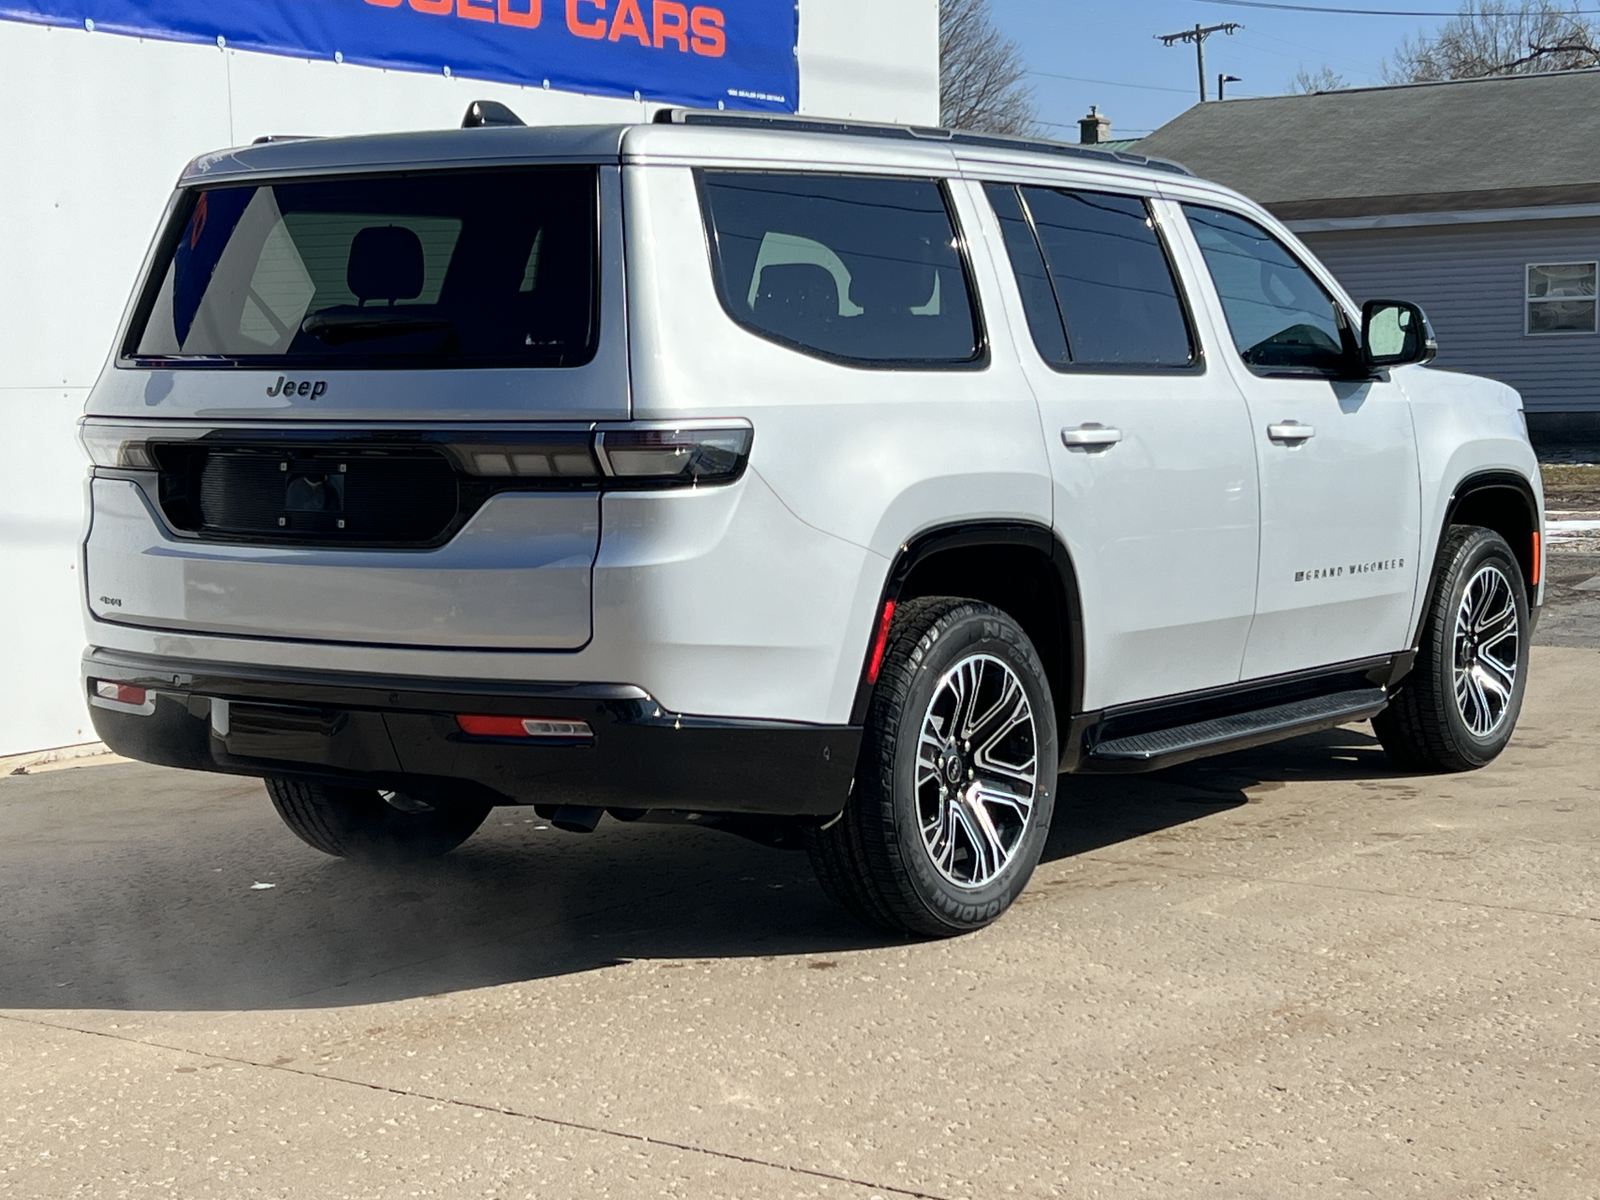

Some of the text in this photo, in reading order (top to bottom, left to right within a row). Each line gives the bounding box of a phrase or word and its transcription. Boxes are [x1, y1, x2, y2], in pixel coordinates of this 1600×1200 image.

[565, 0, 726, 58] CARS
[266, 376, 328, 401] Jeep
[1306, 558, 1404, 581] GRAND WAGONEER
